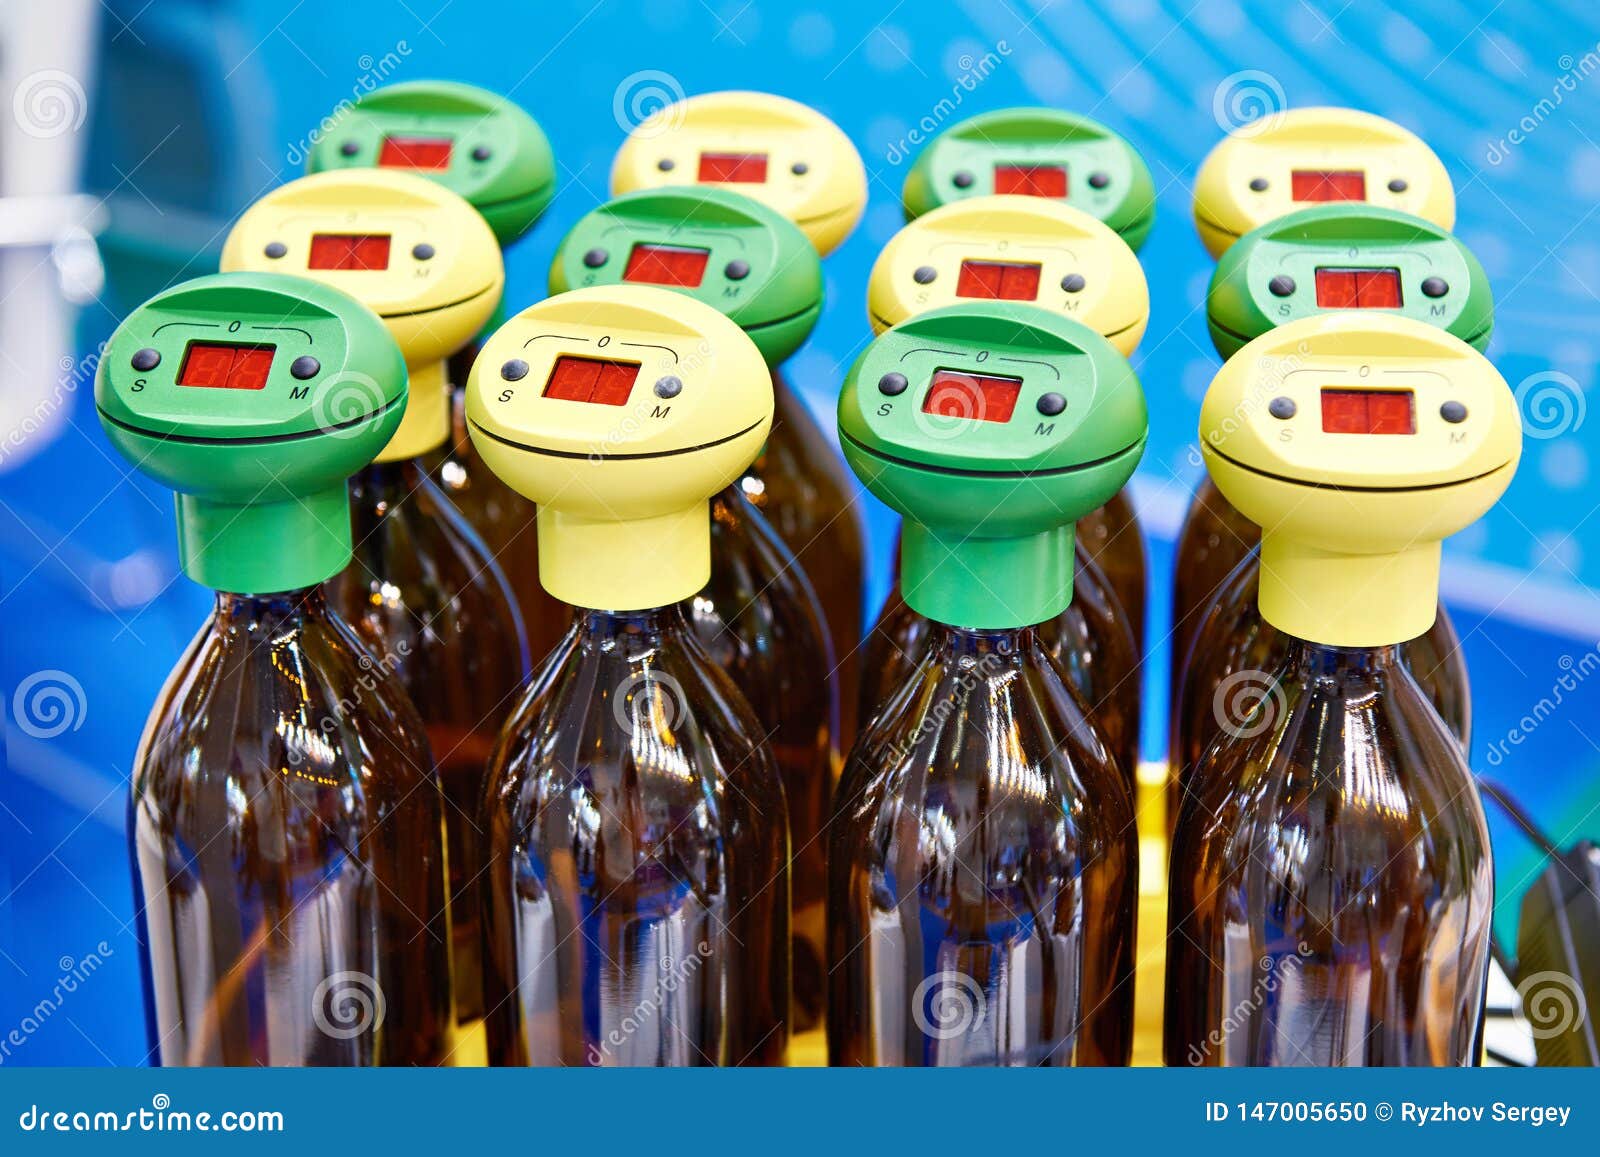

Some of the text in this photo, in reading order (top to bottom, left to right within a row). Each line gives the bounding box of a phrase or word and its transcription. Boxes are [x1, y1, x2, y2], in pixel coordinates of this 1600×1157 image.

[1064, 300, 1080, 311] M
[1279, 304, 1292, 316] S
[1430, 304, 1446, 317] M
[130, 379, 147, 392] S
[289, 386, 310, 400] M
[498, 389, 514, 402] S
[650, 405, 671, 419] M
[877, 403, 893, 416] S
[1034, 422, 1056, 436] M
[1279, 428, 1294, 442] S
[1449, 431, 1467, 443] M
